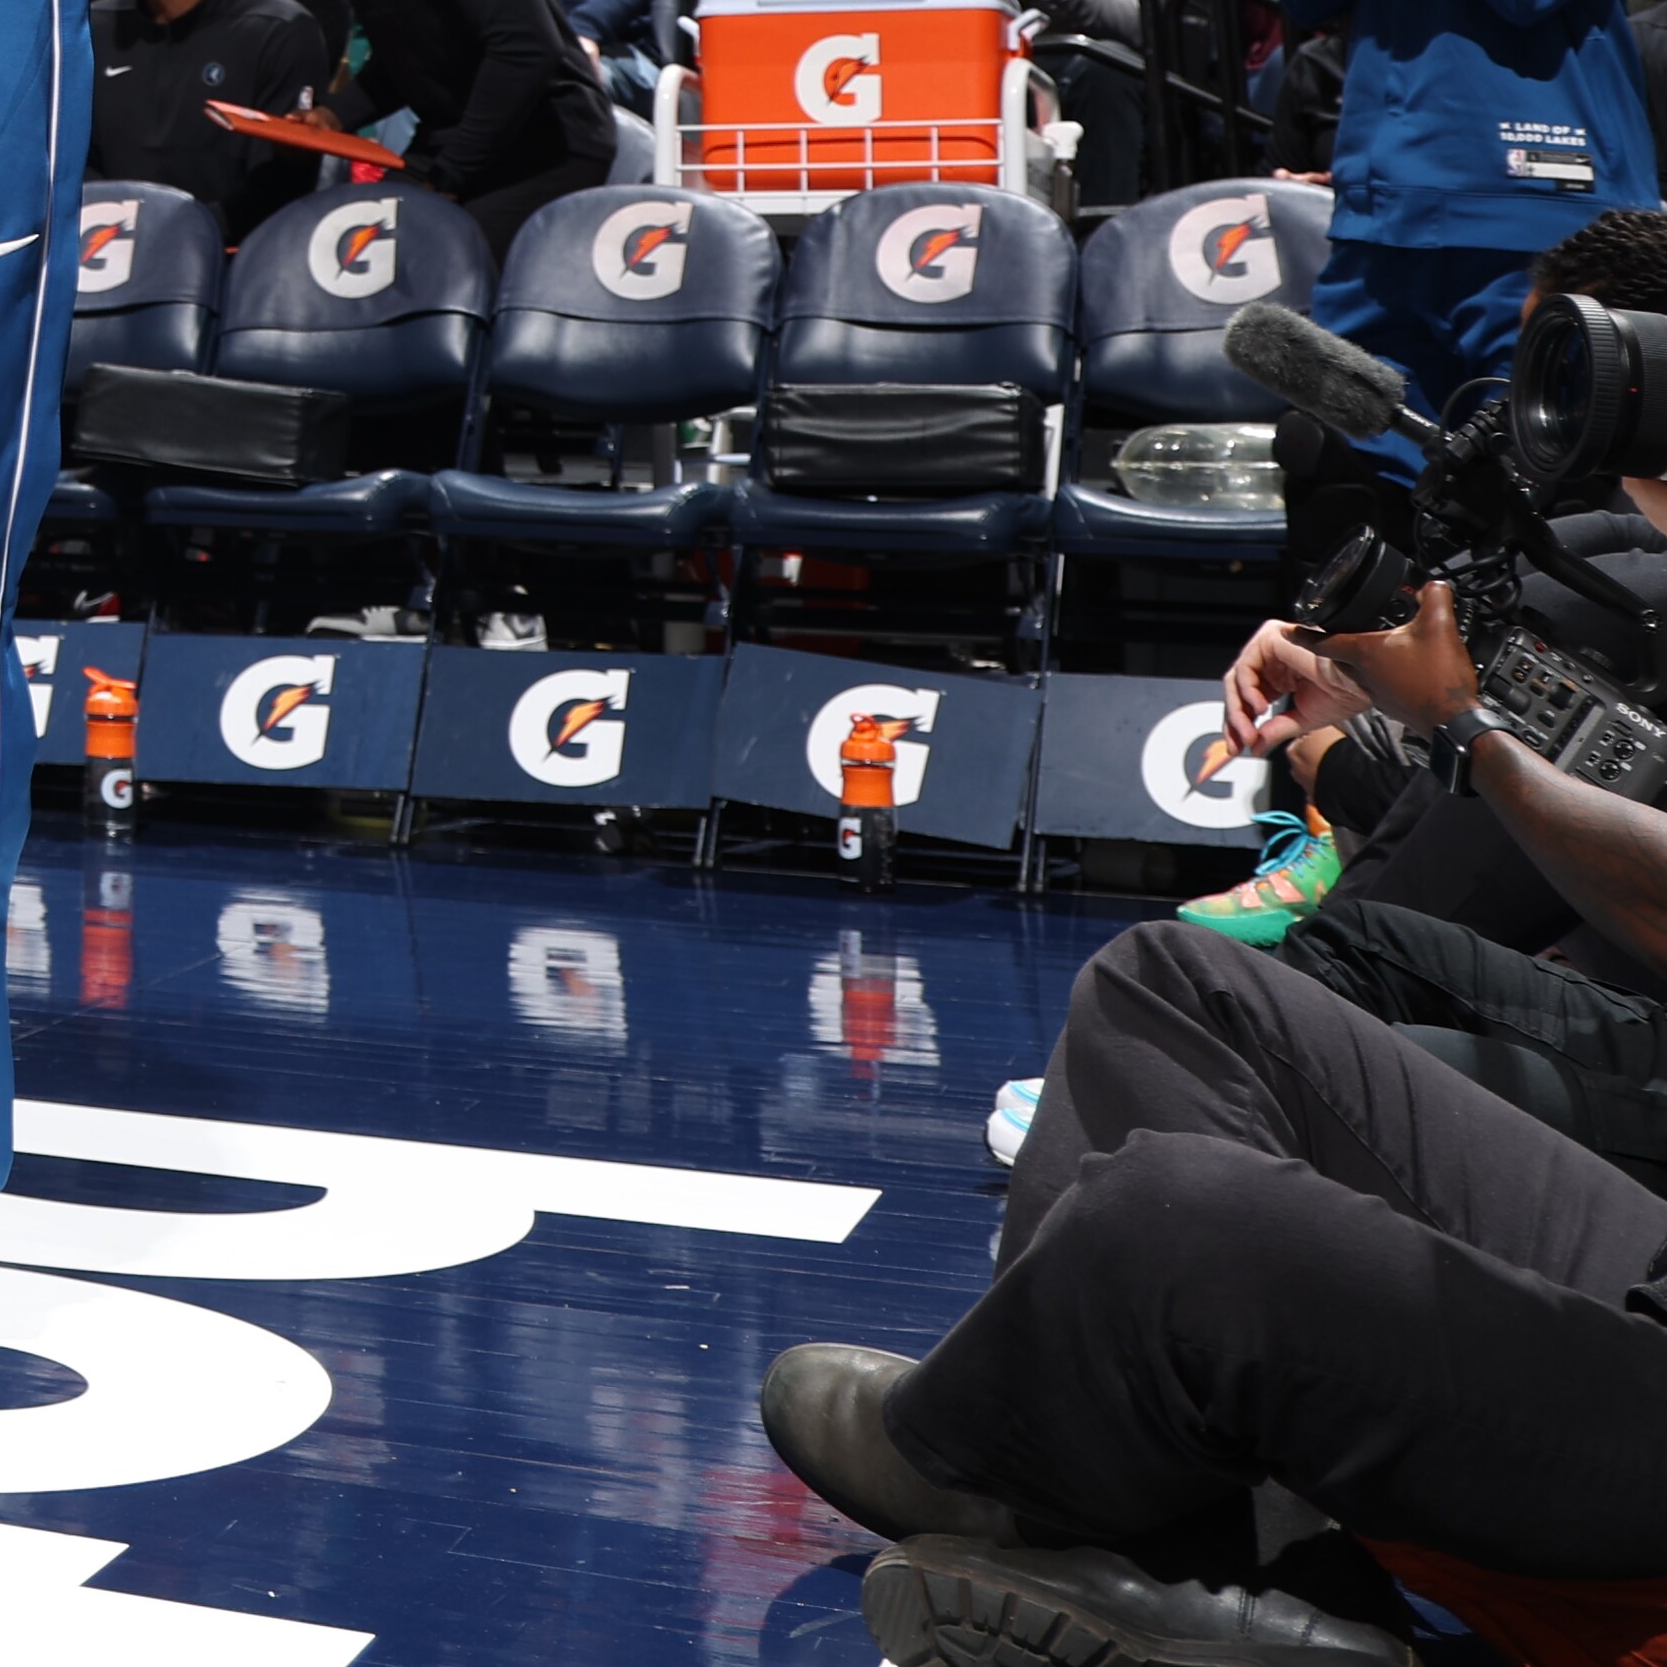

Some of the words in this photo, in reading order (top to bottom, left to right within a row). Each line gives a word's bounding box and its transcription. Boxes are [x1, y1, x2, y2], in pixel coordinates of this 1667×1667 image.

[794, 33, 882, 125] G
[1515, 122, 1550, 133] LAND
[1552, 125, 1571, 135] OF
[1545, 135, 1586, 147] LAKES
[78, 199, 140, 294] G
[308, 197, 399, 299] G
[592, 200, 693, 301] G
[876, 204, 983, 304] G
[1169, 194, 1282, 305] G
[220, 654, 336, 770] G
[509, 669, 629, 788] G
[807, 684, 941, 807] G
[1614, 702, 1667, 739] SONY
[100, 768, 134, 809] G
[1141, 700, 1271, 830] G
[837, 817, 862, 860] G
